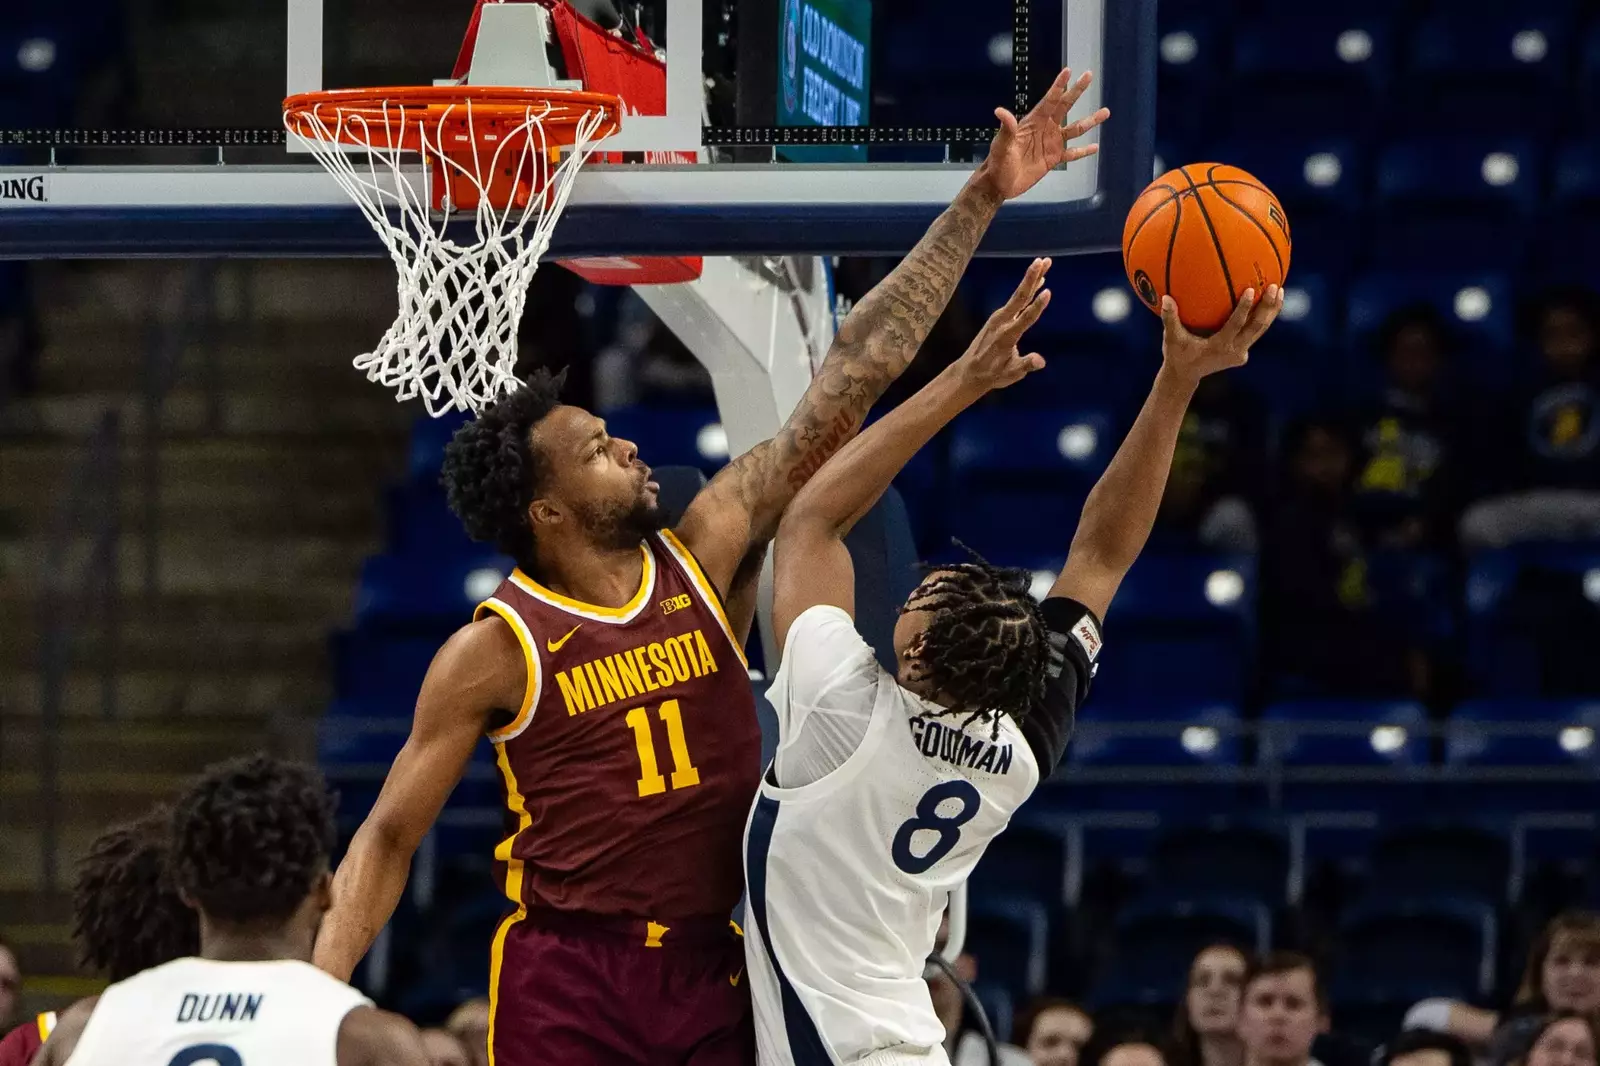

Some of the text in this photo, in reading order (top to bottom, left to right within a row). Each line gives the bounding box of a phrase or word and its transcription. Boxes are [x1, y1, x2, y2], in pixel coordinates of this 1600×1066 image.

[0, 175, 44, 202] ING
[555, 629, 719, 717] MINNESOTA
[625, 699, 700, 797] 11
[891, 780, 981, 875] 8
[176, 993, 264, 1022] DUNN
